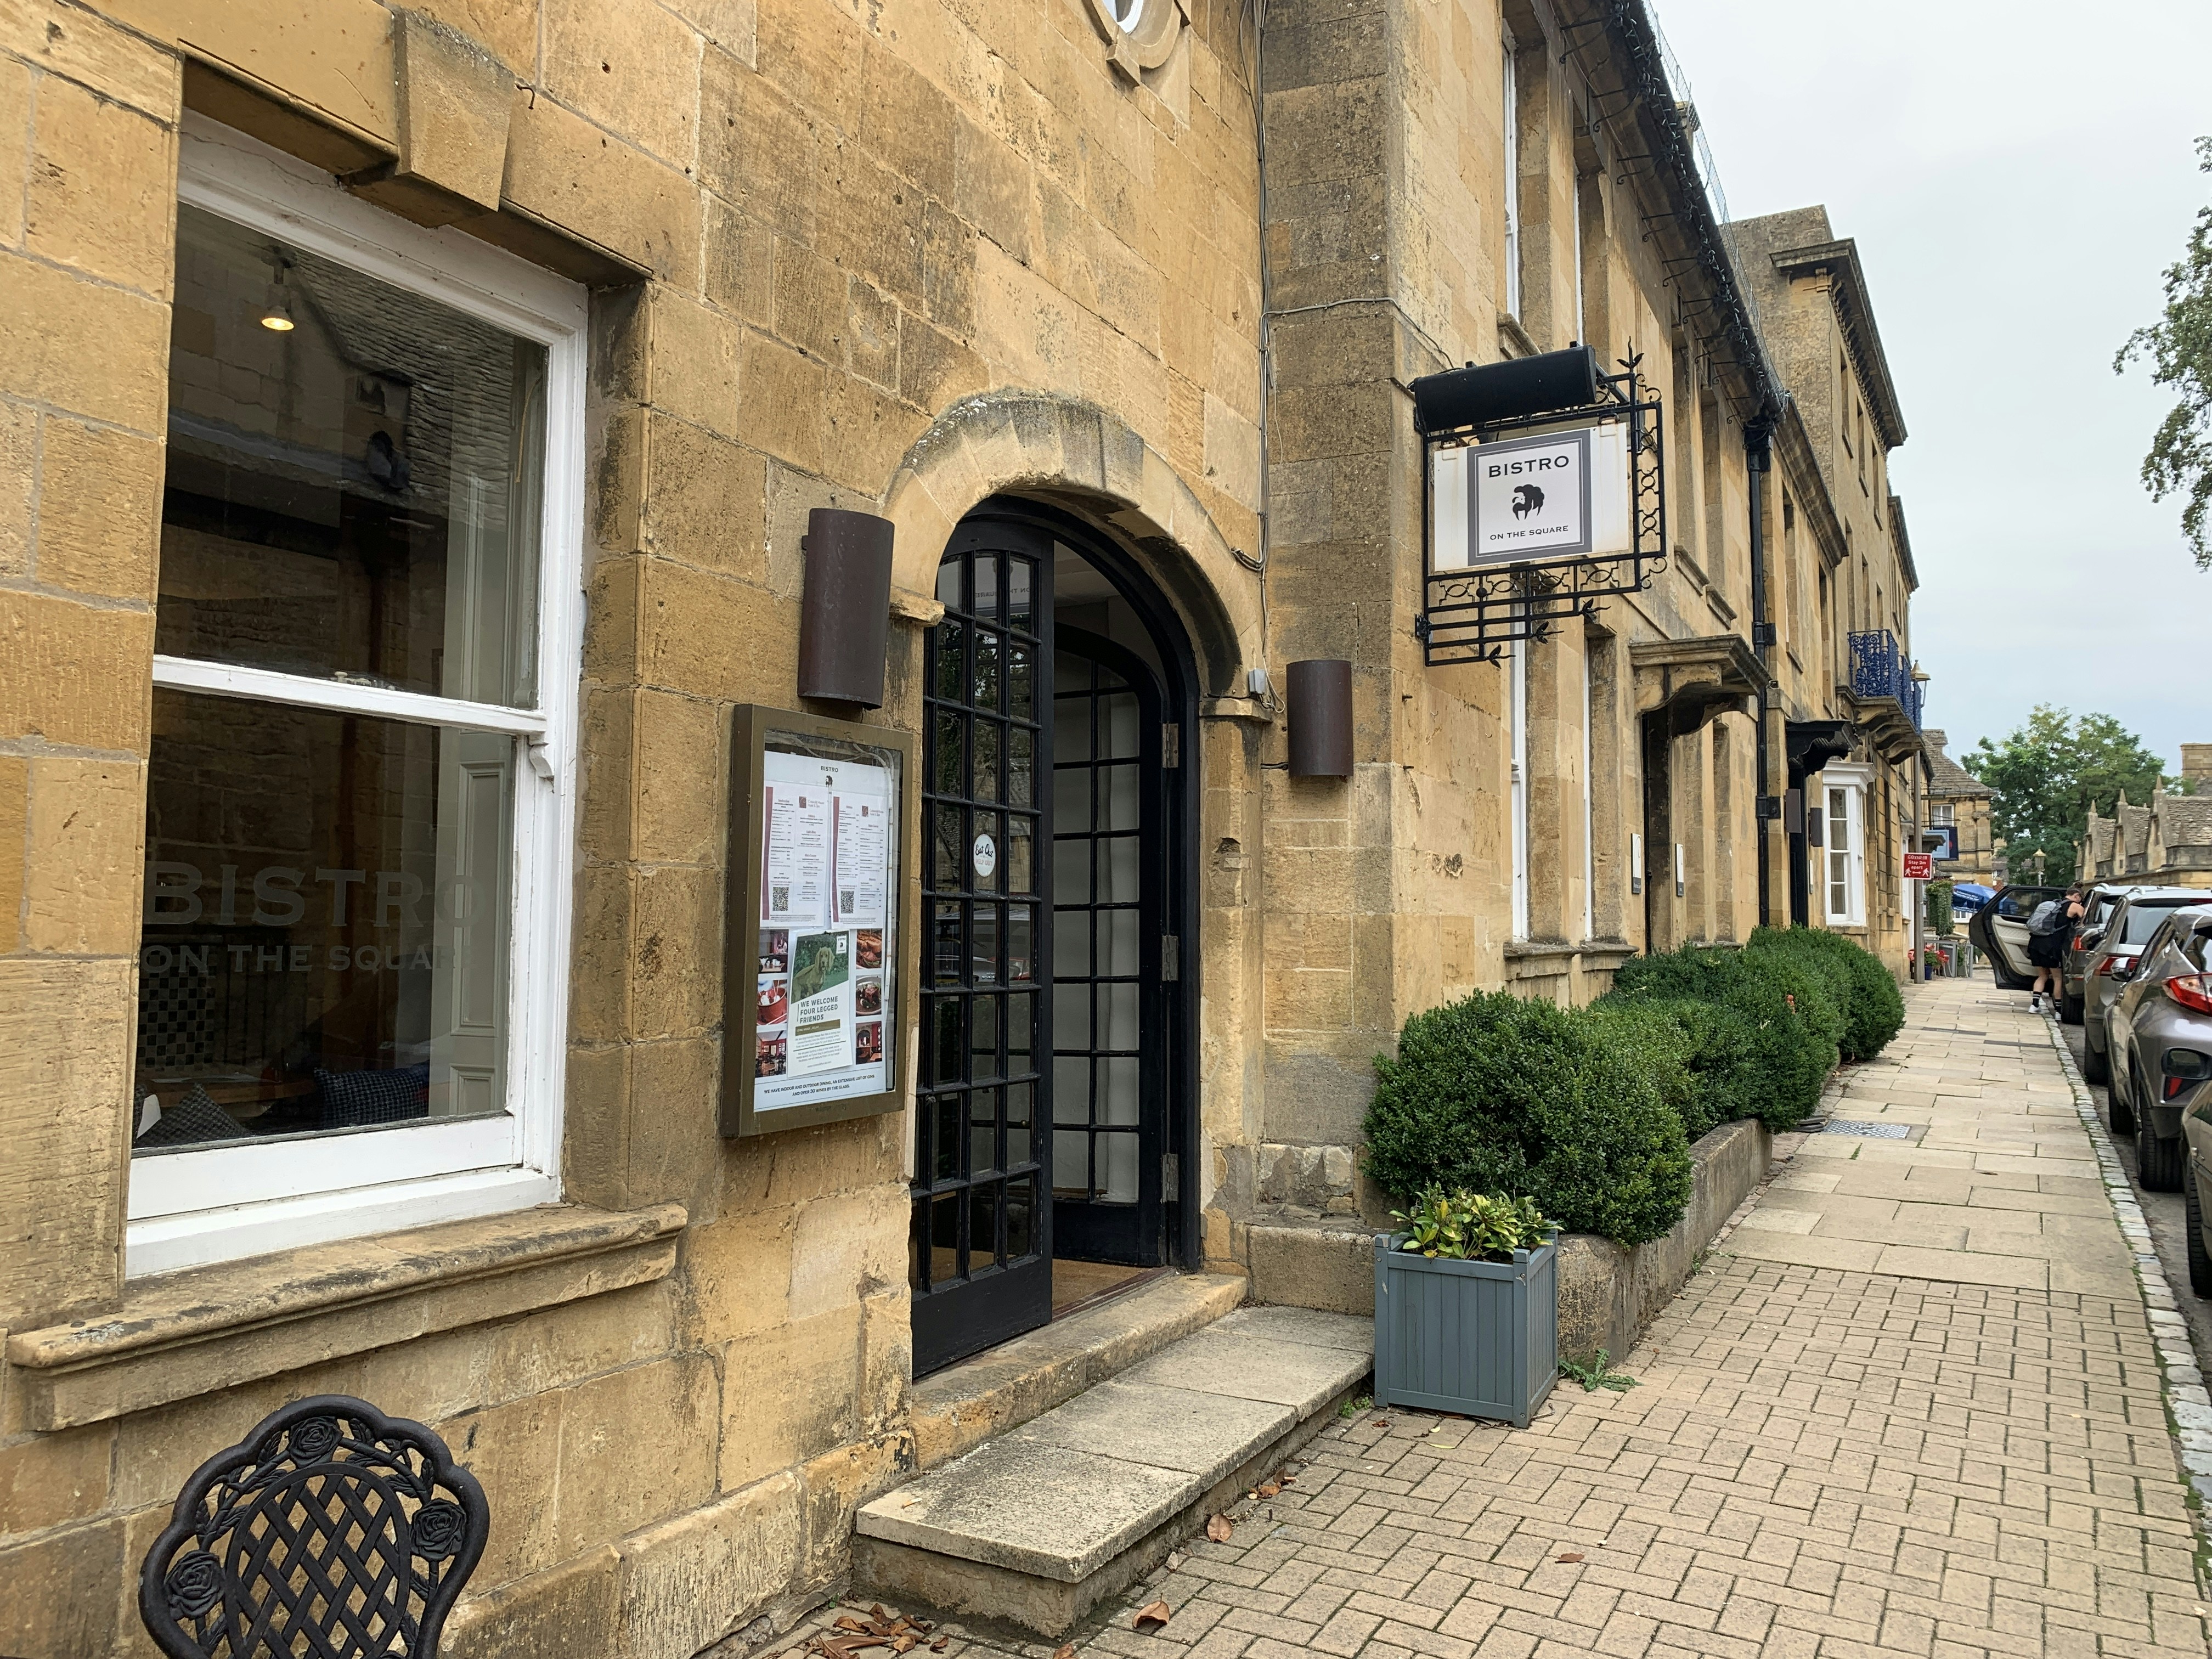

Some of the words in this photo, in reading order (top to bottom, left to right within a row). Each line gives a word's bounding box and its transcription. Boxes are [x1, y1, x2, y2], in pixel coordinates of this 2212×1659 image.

[1488, 455, 1570, 478] BISTRO
[1529, 525, 1569, 536] SQUARE
[975, 844, 984, 856] Eat
[985, 844, 994, 857] Out
[144, 944, 210, 973] ON
[227, 944, 313, 973] THE
[811, 996, 838, 1006] WELCOME
[817, 1004, 838, 1013] LEGGED
[800, 1014, 824, 1024] FRIENDS
